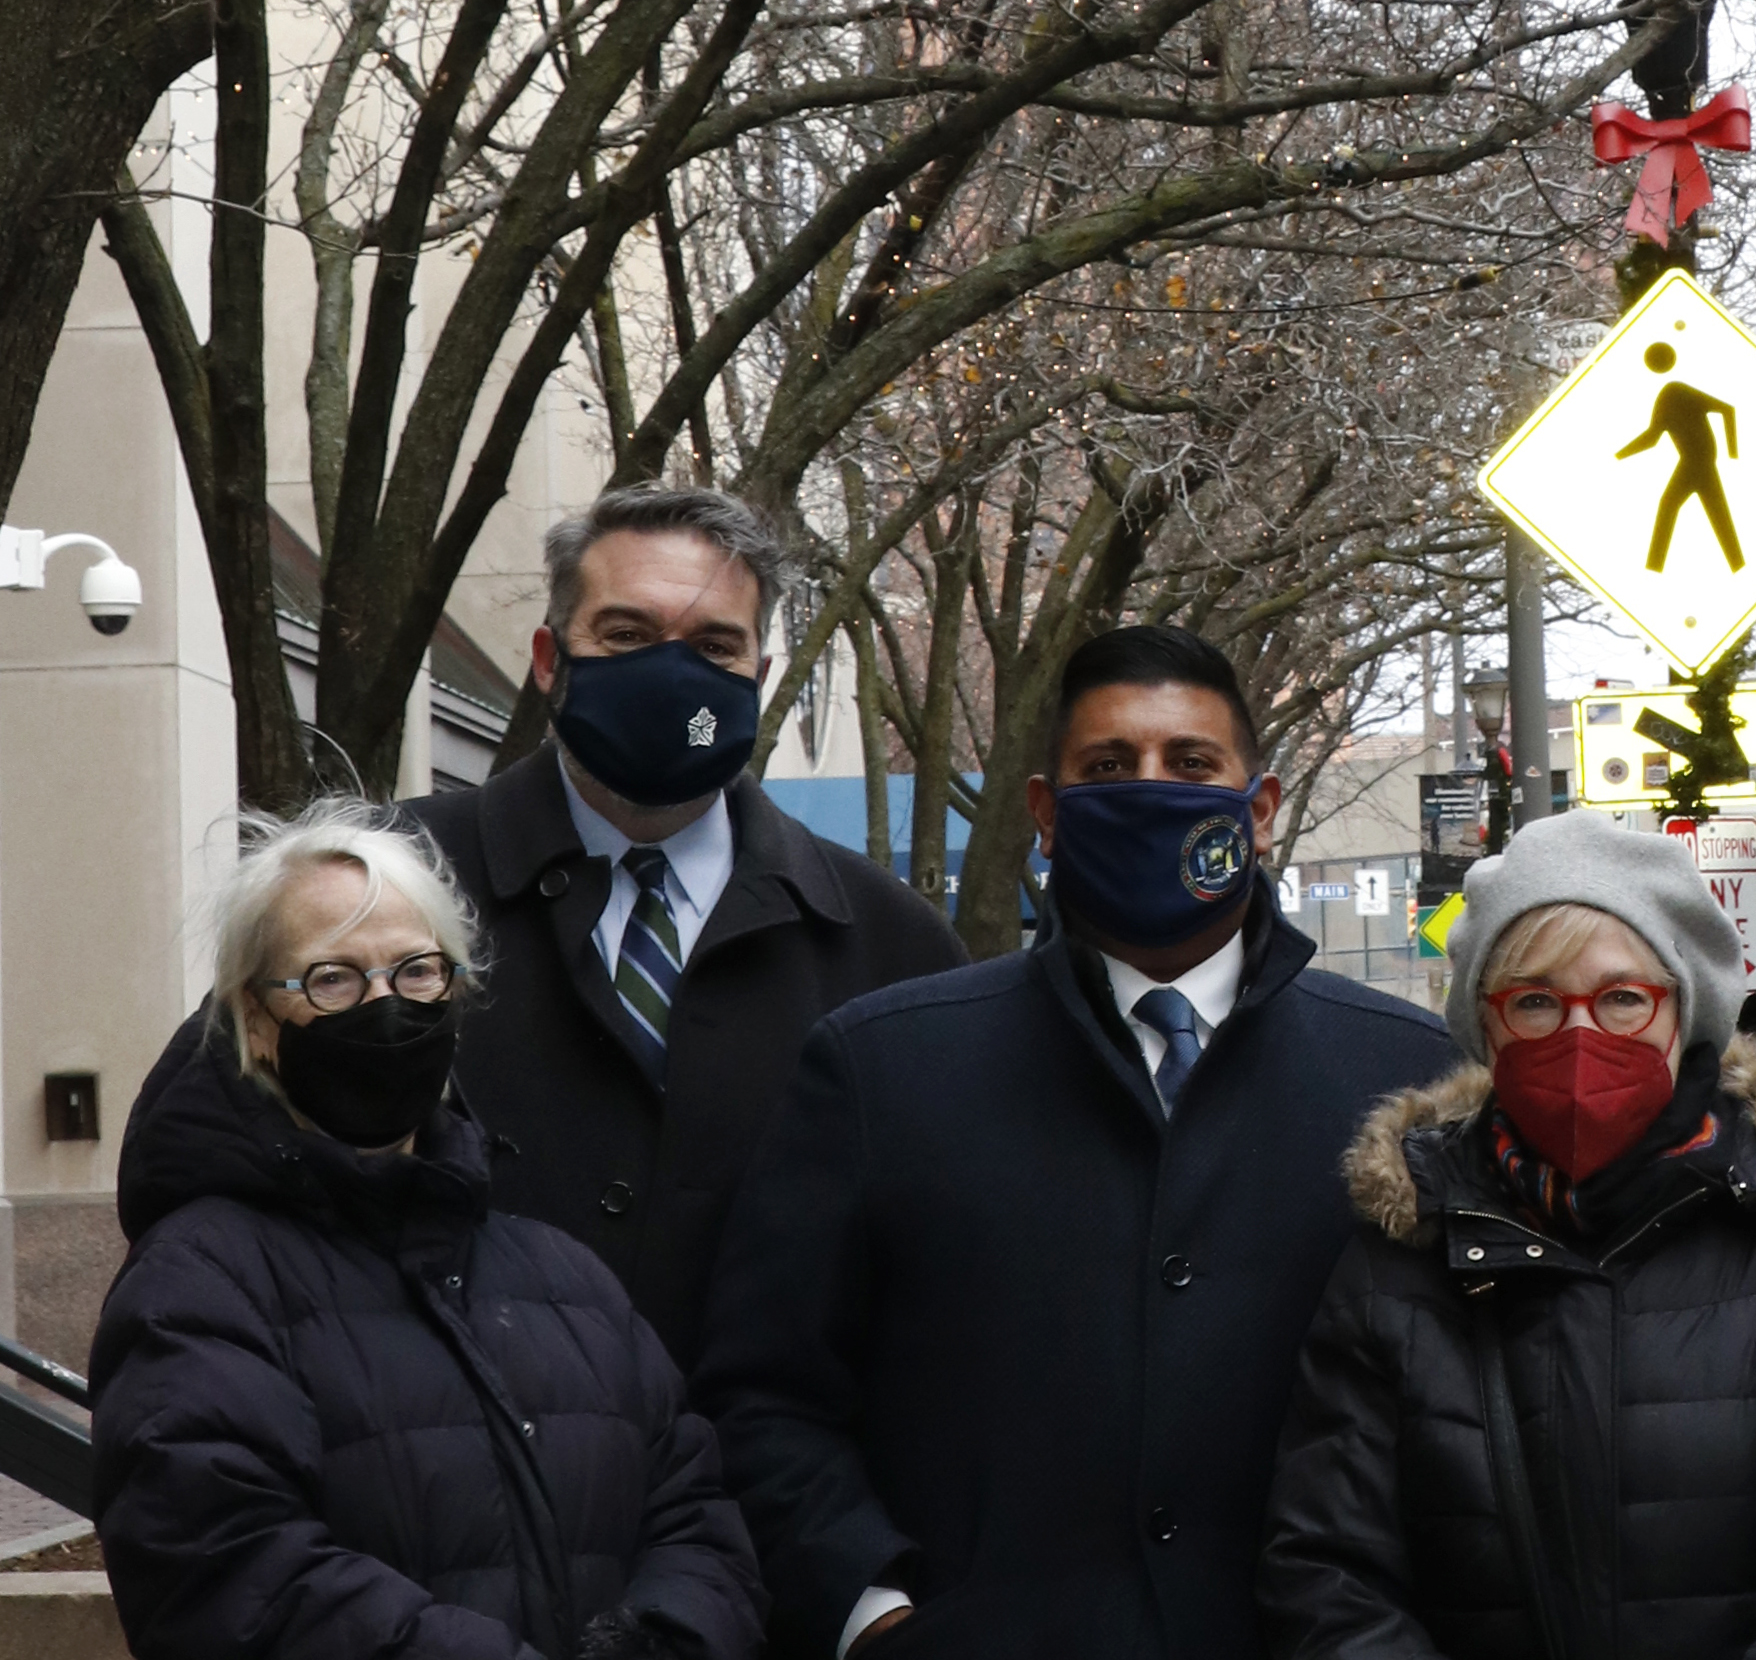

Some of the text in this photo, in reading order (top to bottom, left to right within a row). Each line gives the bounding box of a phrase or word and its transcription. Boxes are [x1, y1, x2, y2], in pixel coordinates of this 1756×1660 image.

[1701, 837, 1756, 860] STOPPING
[1314, 885, 1346, 899] MAIN
[1710, 877, 1744, 909] NY
